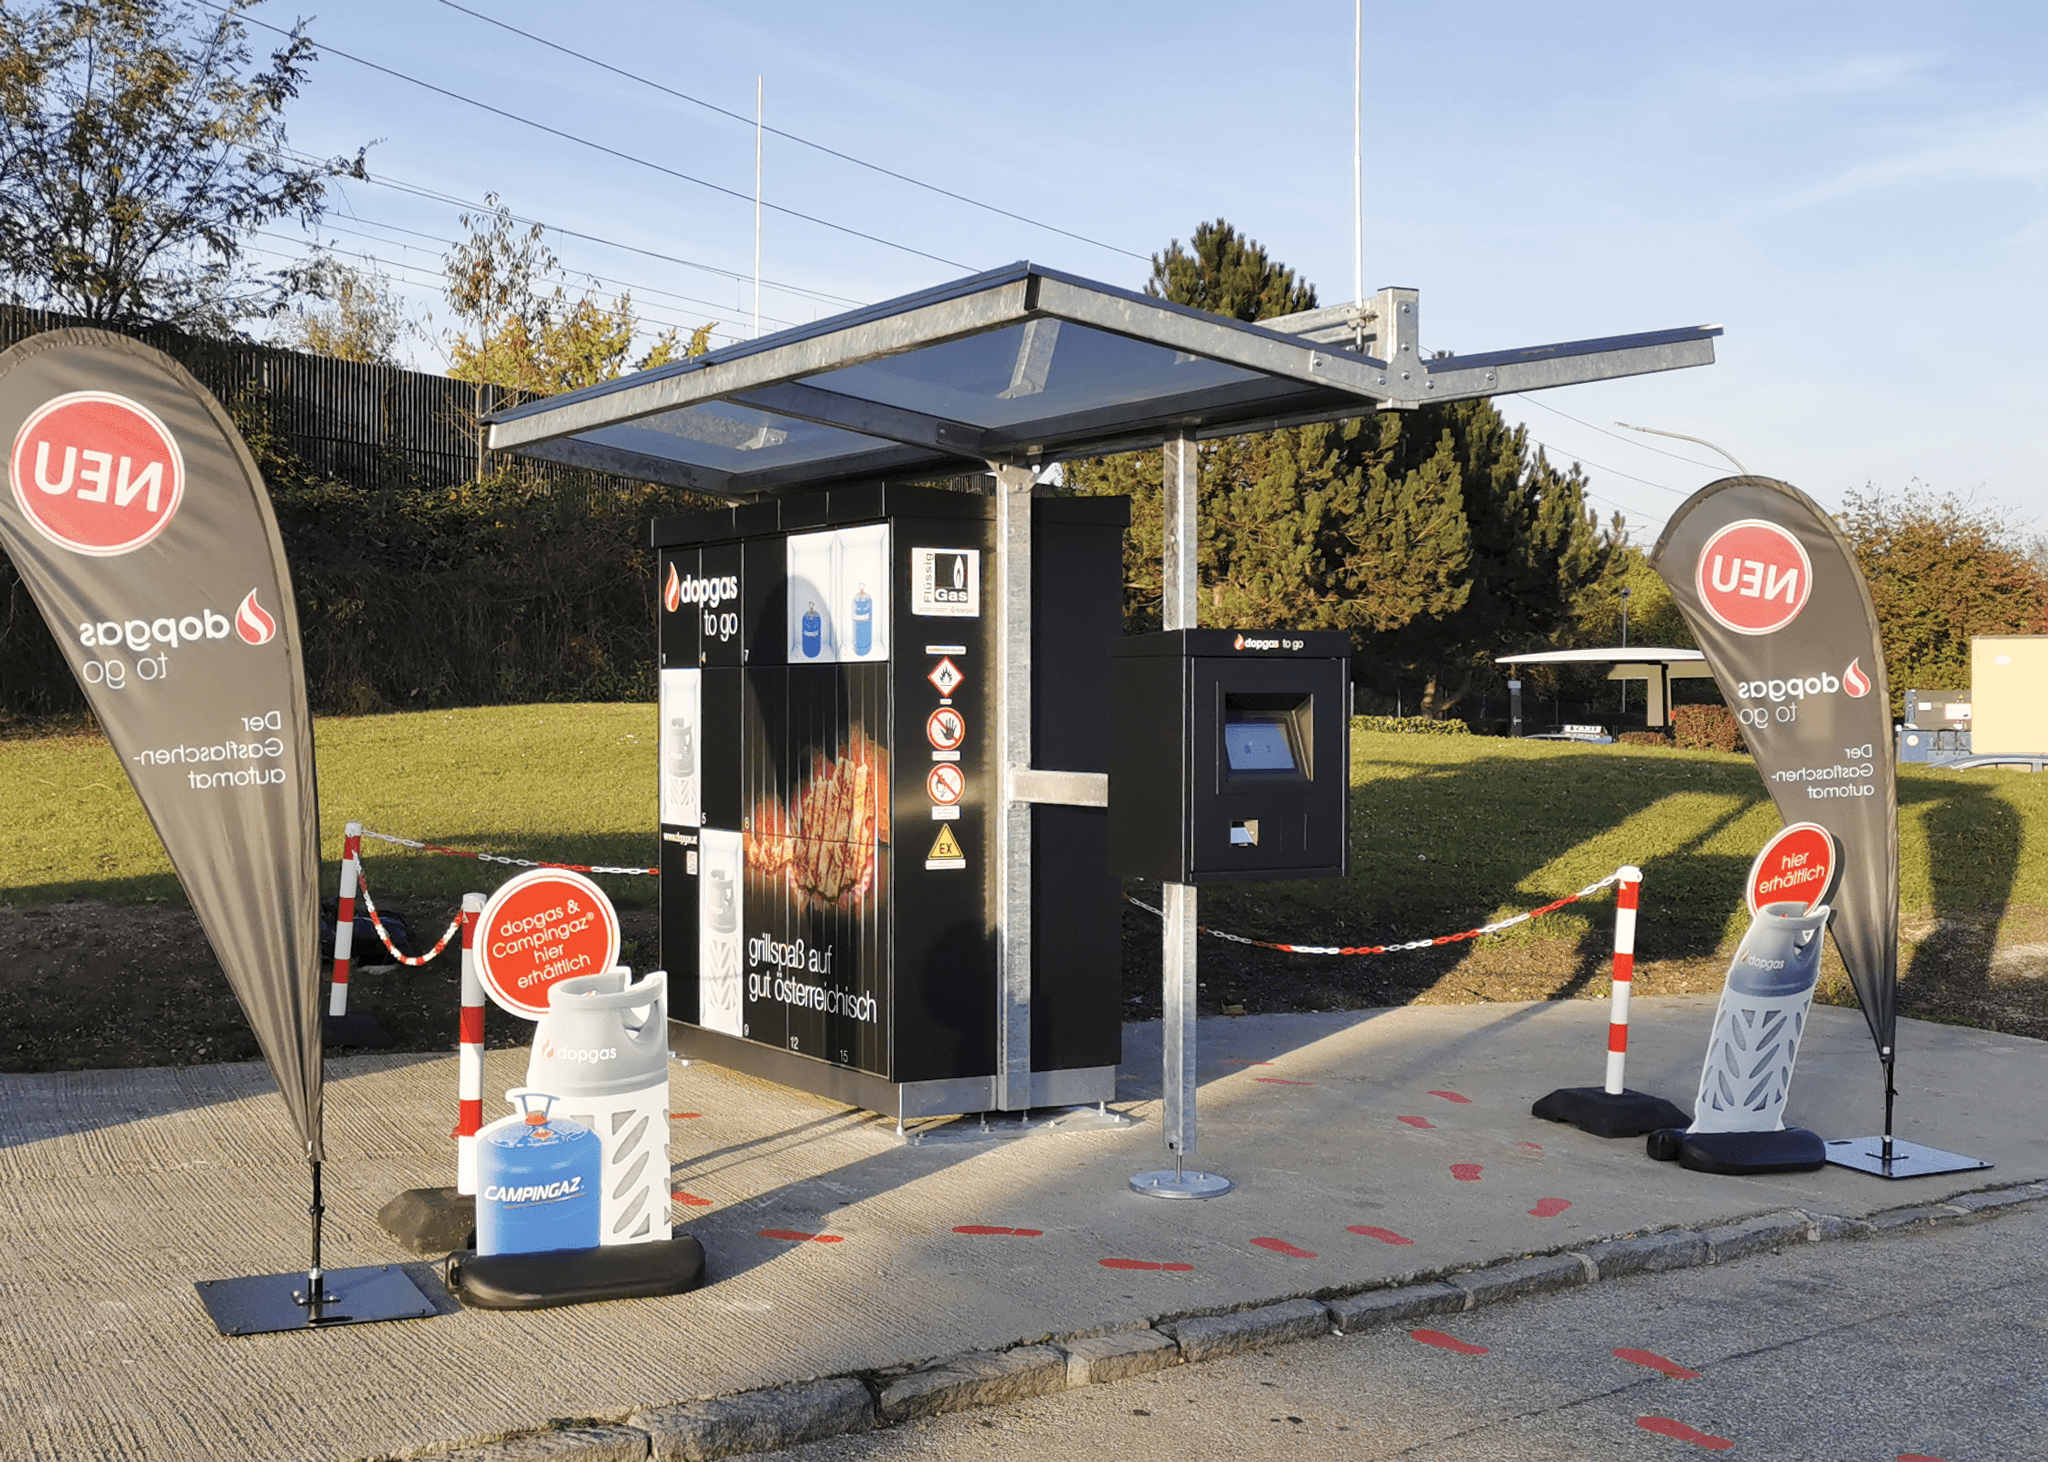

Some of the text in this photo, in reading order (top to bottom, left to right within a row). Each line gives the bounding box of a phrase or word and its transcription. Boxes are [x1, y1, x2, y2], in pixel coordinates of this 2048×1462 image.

[924, 553, 934, 603] Flüssig
[681, 574, 738, 608] dopgas
[935, 588, 968, 602] Gas
[704, 609, 738, 642] to go
[1245, 637, 1304, 651] dopgas to go
[744, 649, 749, 662] 7
[701, 812, 706, 824] 5
[939, 843, 952, 854] EX
[1781, 852, 1810, 870] hier
[1759, 864, 1825, 894] erhältlich
[500, 899, 580, 937] dopgas &
[533, 944, 564, 965] hier
[749, 932, 833, 975] grillspaß auf
[1748, 955, 1785, 971] dopgas
[517, 953, 591, 989] erhältlich
[749, 970, 877, 1024] gut österreichisch
[744, 1024, 749, 1036] 9
[790, 1036, 799, 1050] 12
[556, 1045, 617, 1064] dopgas
[840, 1049, 848, 1062] 15
[484, 1176, 583, 1202] CAMPINGAZ
